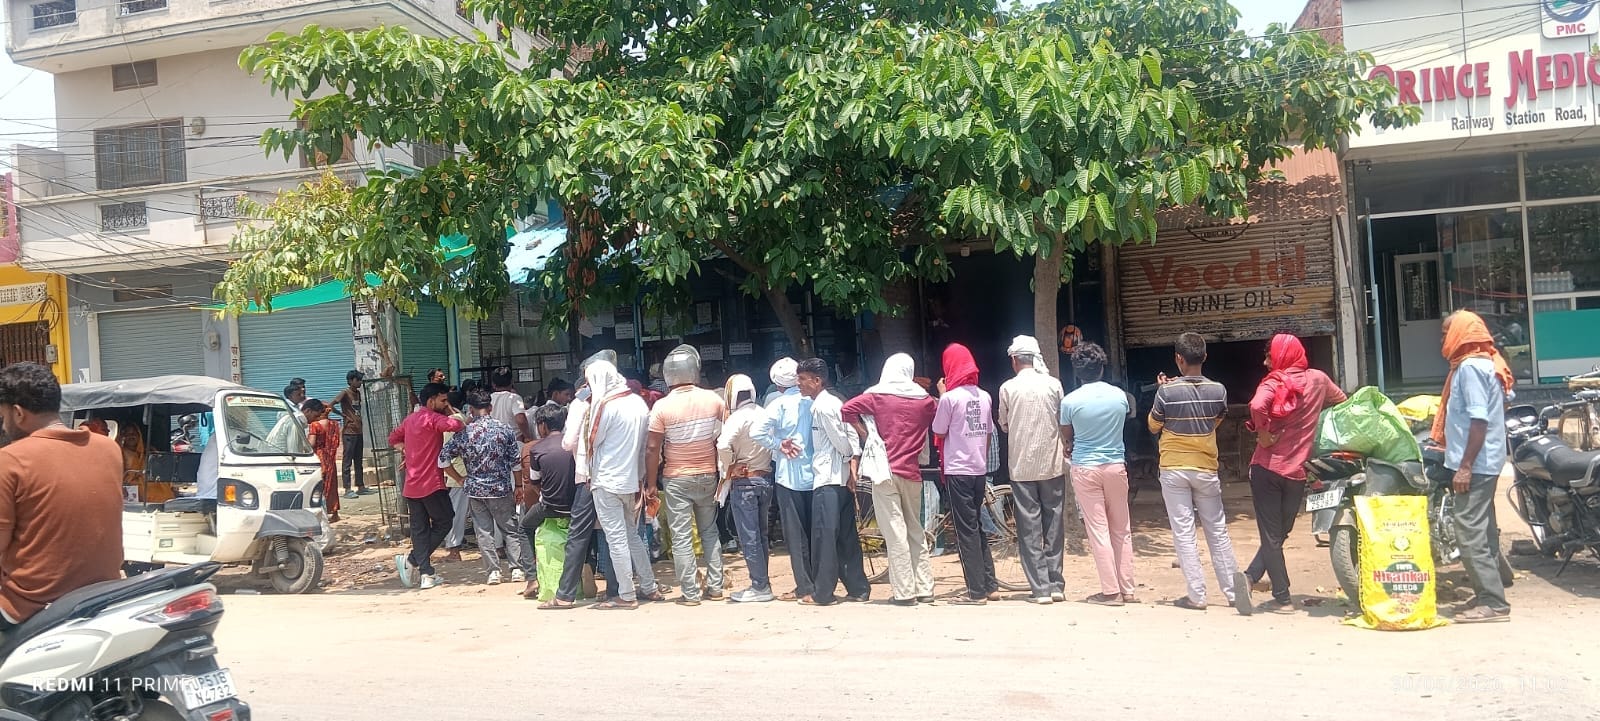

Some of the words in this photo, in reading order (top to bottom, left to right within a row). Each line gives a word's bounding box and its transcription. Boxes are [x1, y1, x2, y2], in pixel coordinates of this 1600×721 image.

[1555, 23, 1587, 36] PMC
[1451, 115, 1494, 131] Railway
[1505, 110, 1545, 127] Station
[1555, 105, 1587, 122] Road,
[1158, 293, 1235, 315] ENGINE
[1244, 289, 1296, 309] OILS
[195, 684, 232, 705] N4732
